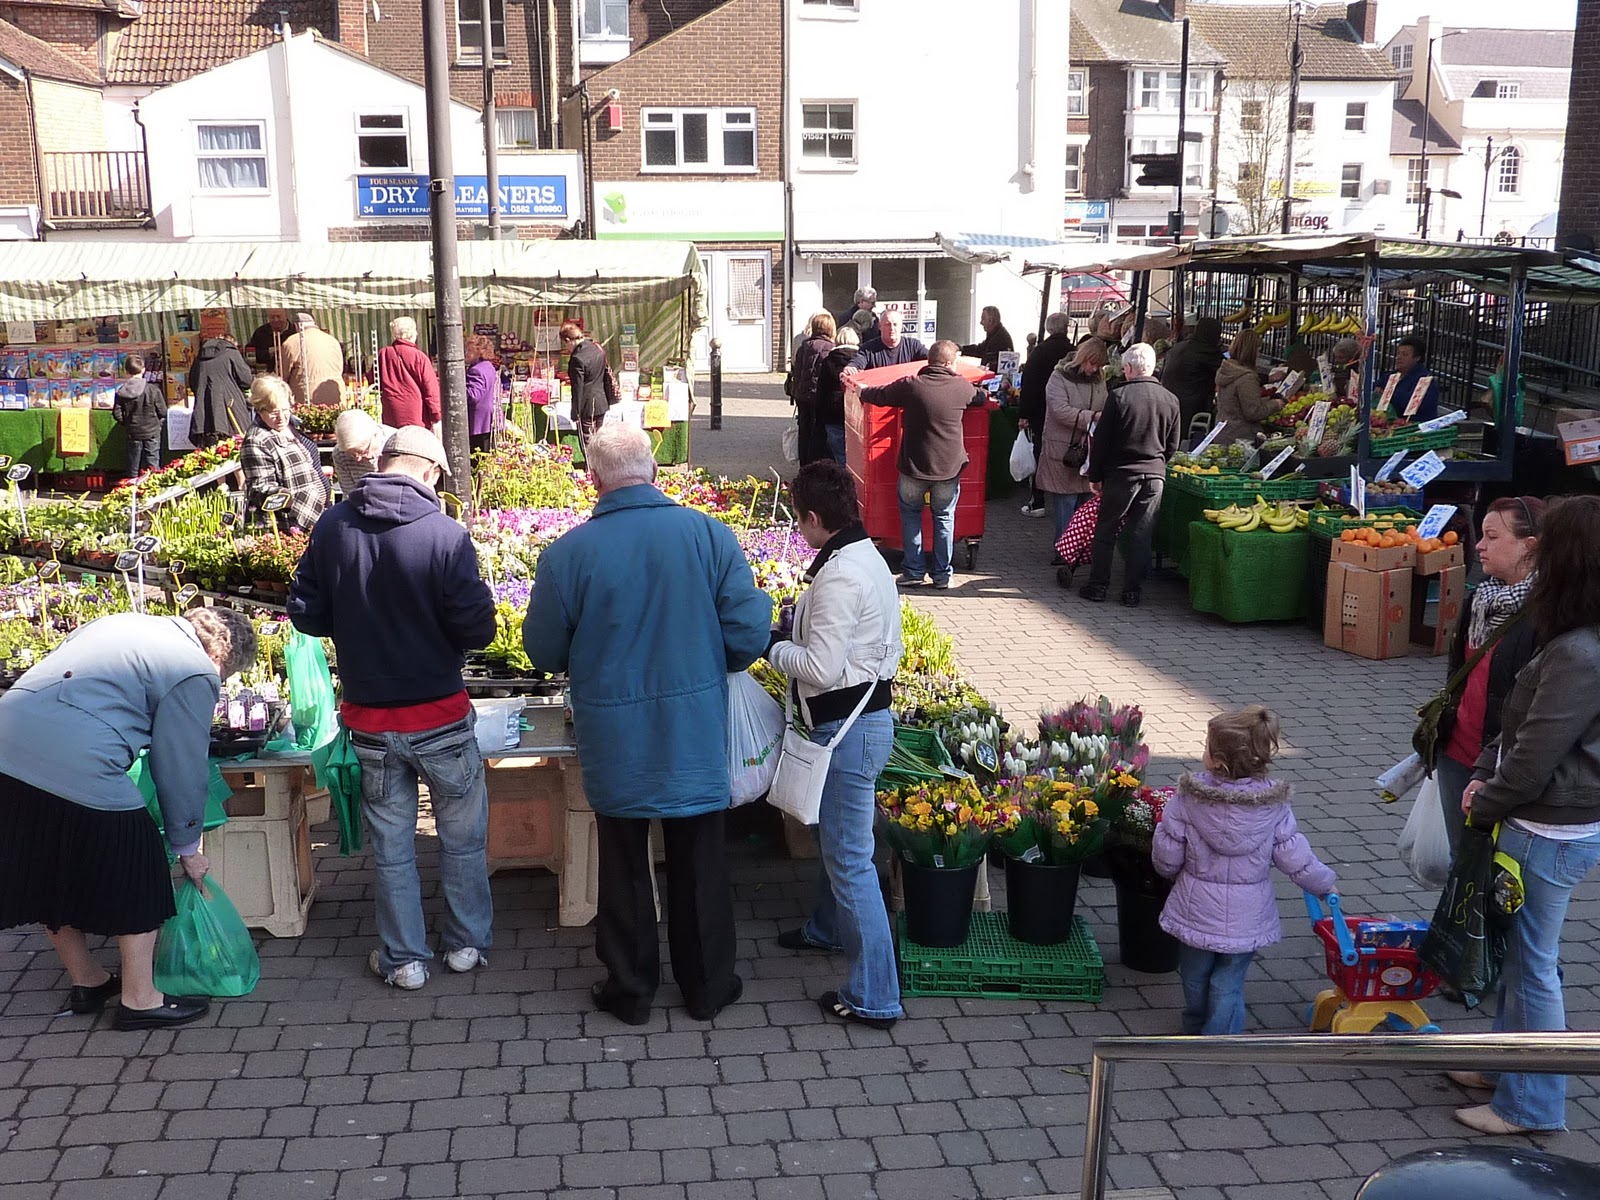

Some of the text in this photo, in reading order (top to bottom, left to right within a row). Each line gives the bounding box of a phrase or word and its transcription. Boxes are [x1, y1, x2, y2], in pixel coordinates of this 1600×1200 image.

[370, 187, 419, 204] DRY
[363, 206, 374, 214] 34
[884, 303, 898, 311] TO
